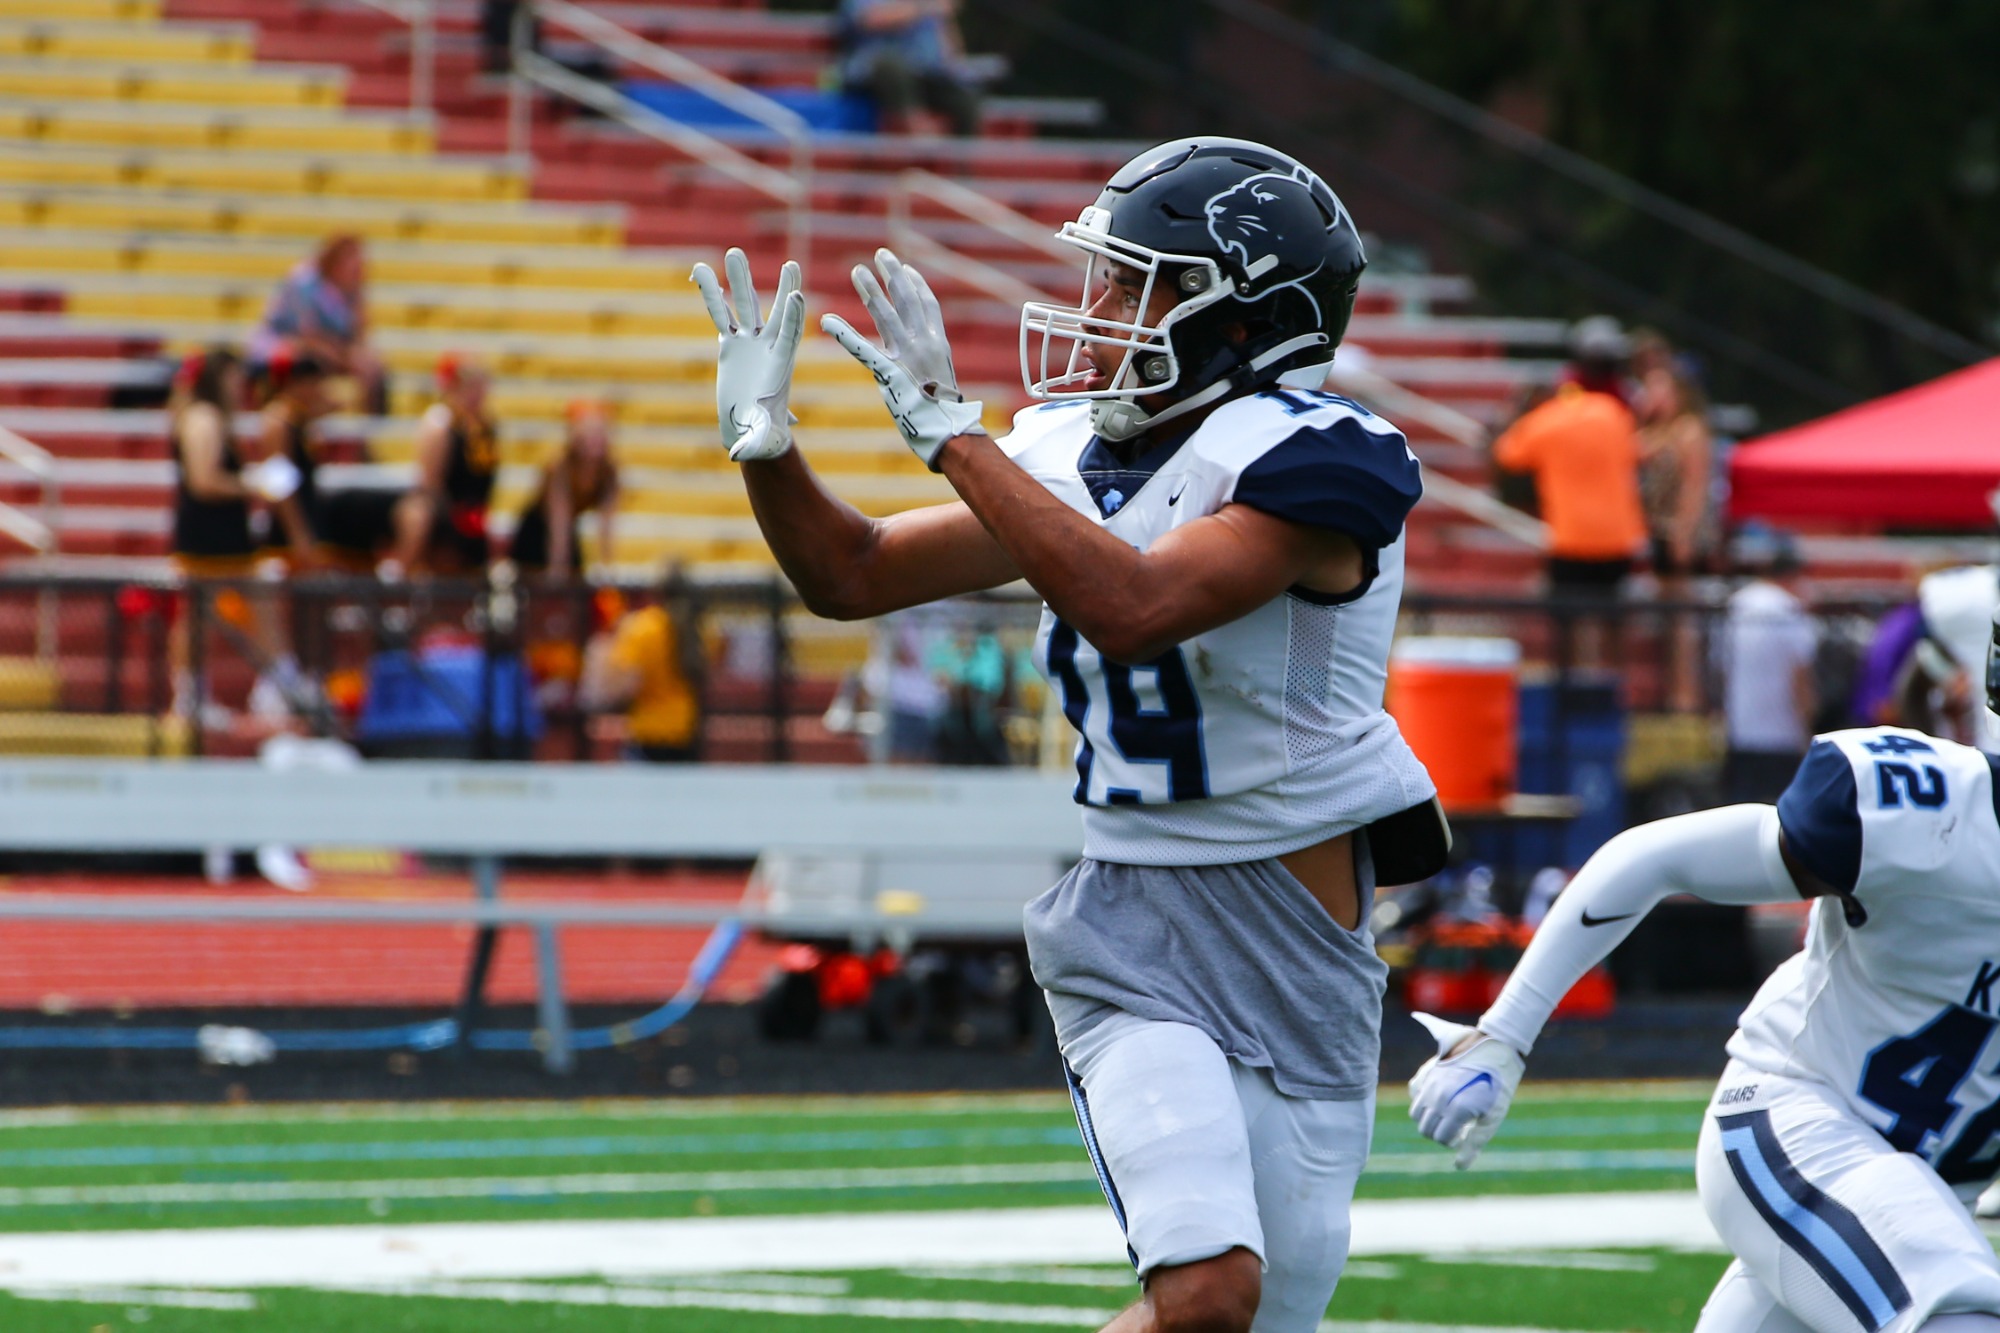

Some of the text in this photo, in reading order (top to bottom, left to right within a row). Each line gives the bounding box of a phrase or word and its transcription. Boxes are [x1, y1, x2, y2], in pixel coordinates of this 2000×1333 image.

[1047, 618, 1212, 807] 19
[1862, 734, 1949, 812] 42
[1964, 959, 2000, 1014] K
